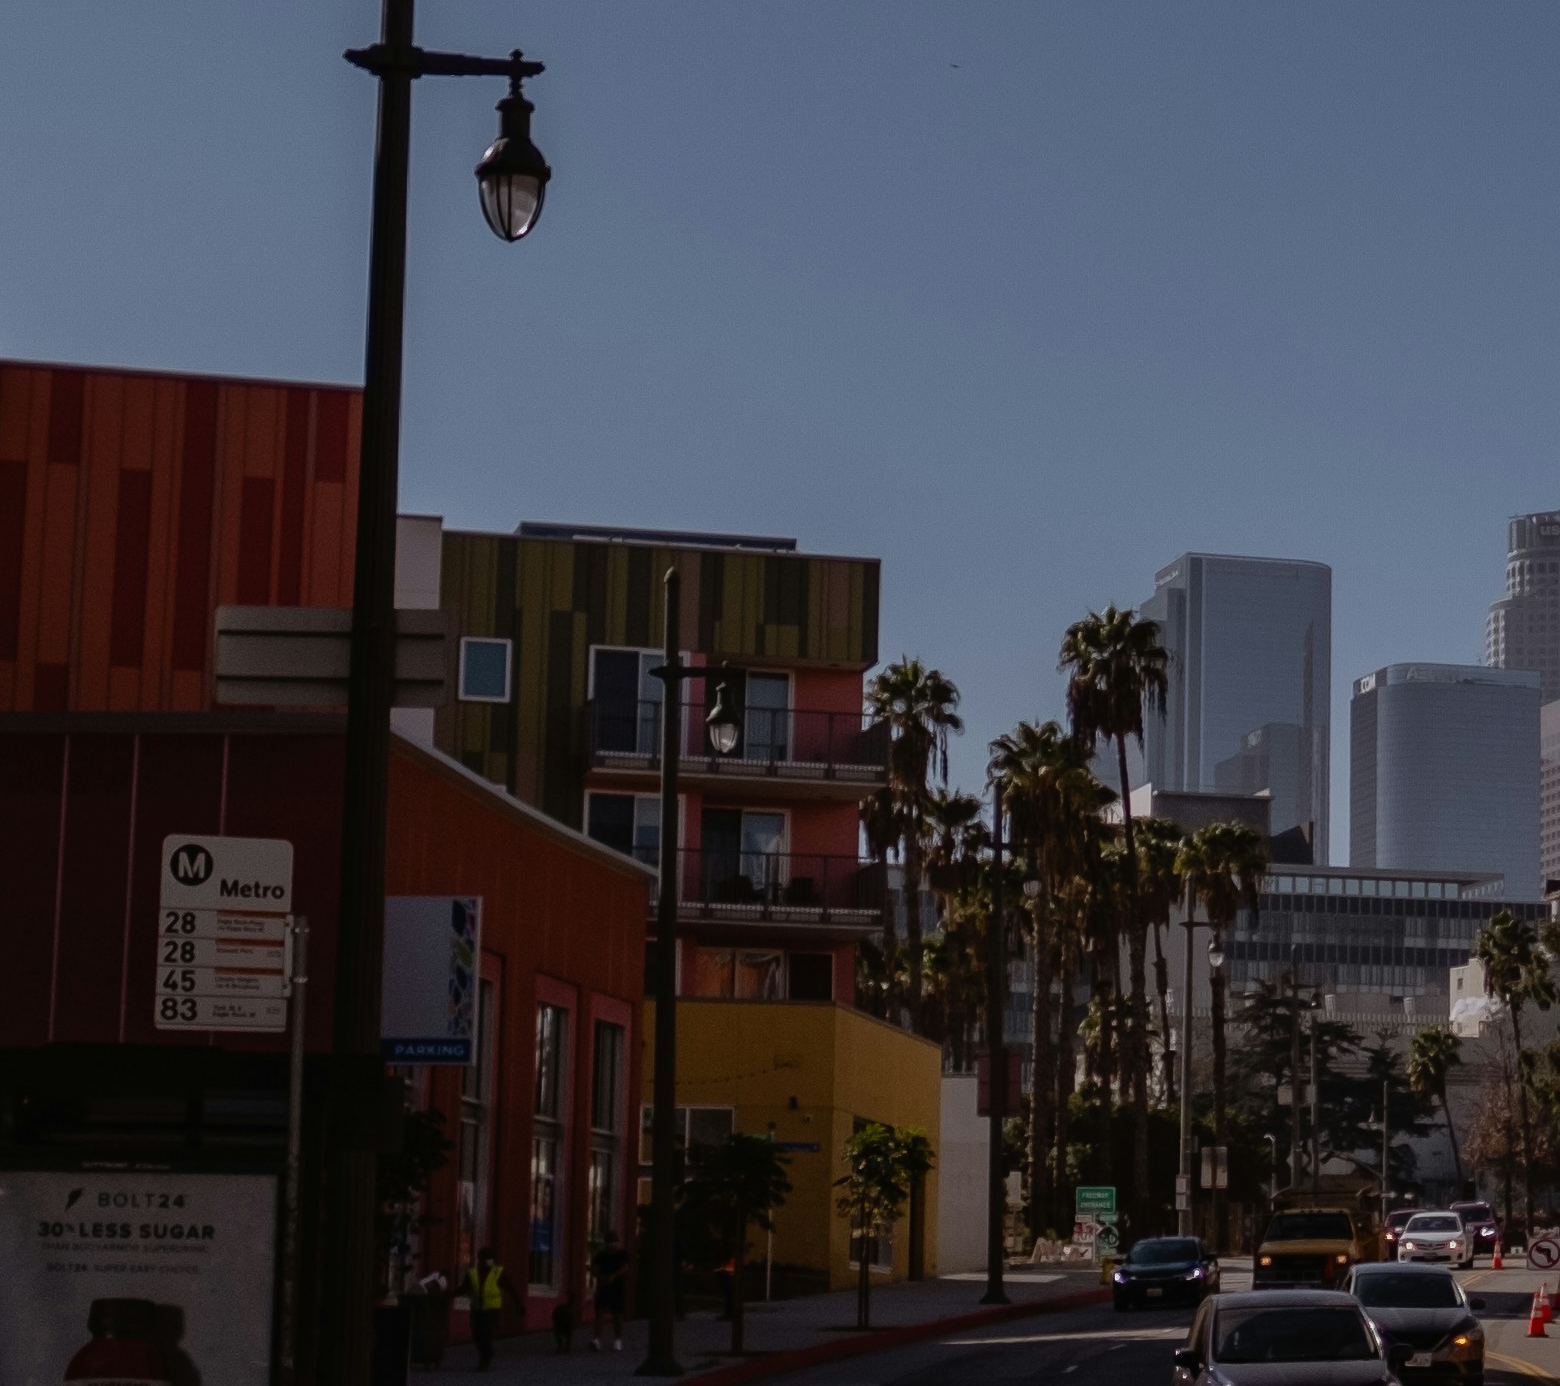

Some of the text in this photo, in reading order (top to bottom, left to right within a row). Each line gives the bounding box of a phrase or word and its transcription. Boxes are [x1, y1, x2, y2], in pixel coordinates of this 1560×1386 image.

[178, 852, 206, 879] M
[219, 879, 285, 900] Metro
[165, 911, 196, 934] 28
[163, 940, 195, 963] 28
[162, 969, 196, 992] 45
[160, 998, 198, 1021] 83
[394, 1044, 465, 1056] PARKING
[98, 1192, 185, 1209] BOLT24
[79, 1222, 132, 1239] LESS
[139, 1223, 216, 1240] SUGAR
